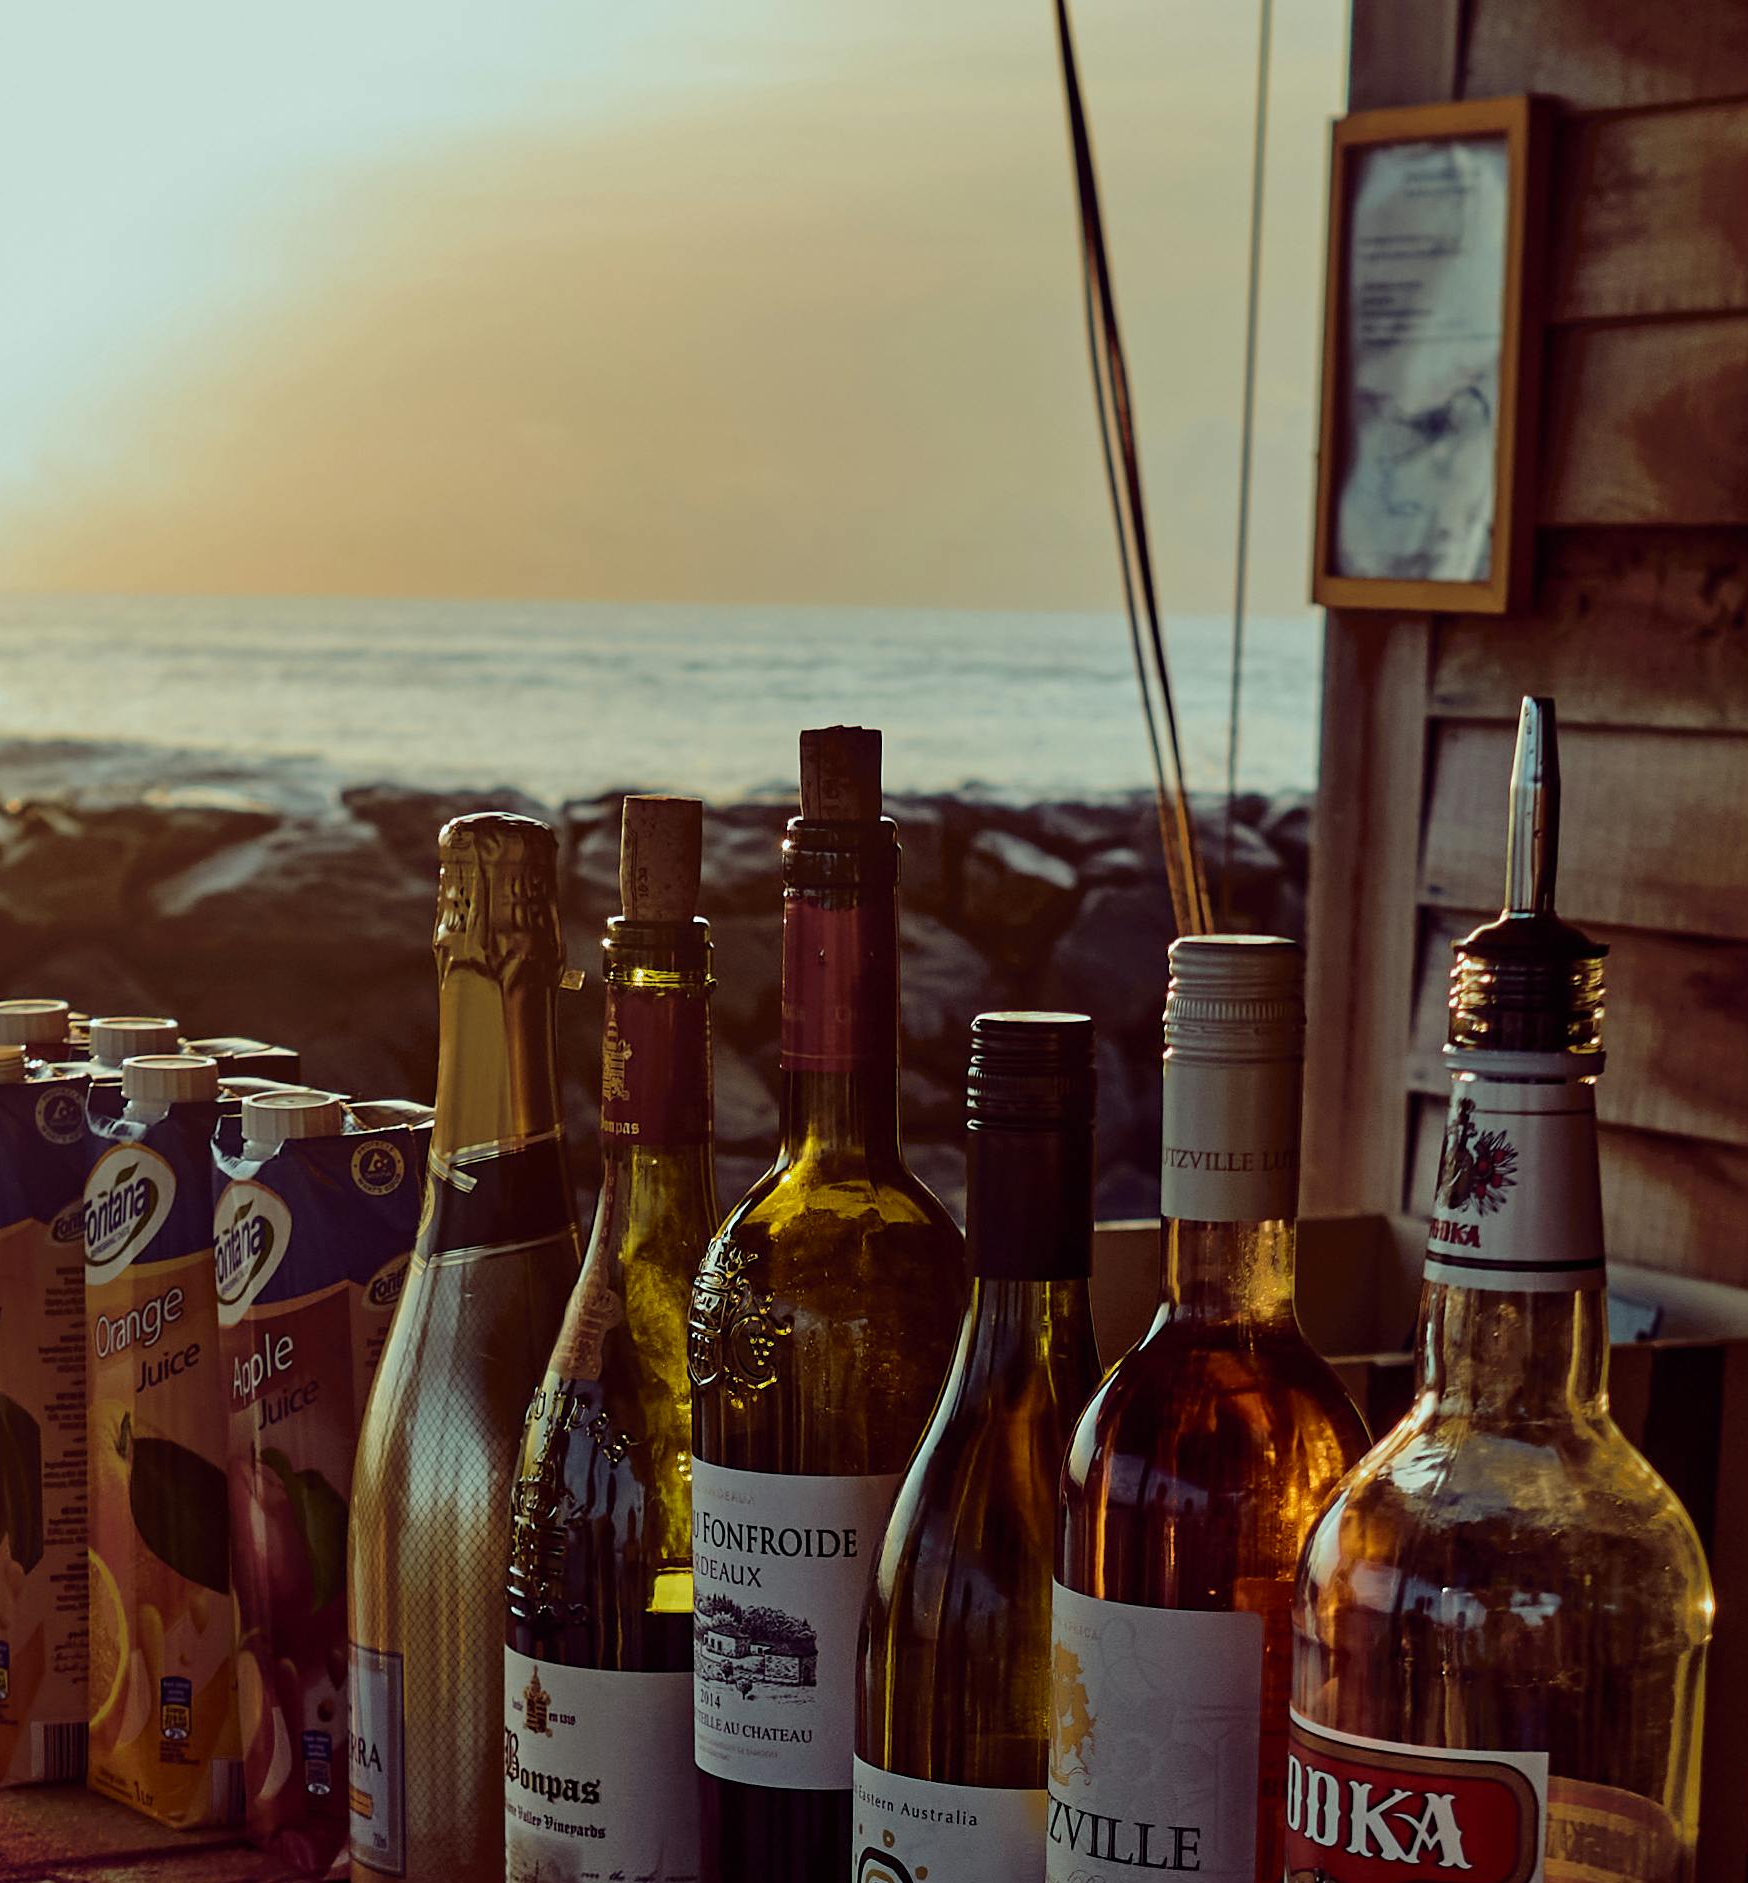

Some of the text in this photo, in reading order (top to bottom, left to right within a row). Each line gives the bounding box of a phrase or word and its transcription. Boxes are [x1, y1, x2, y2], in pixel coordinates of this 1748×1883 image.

[96, 1286, 184, 1359] Orange
[137, 1343, 200, 1393] Juice
[233, 1332, 294, 1402] Apple
[259, 1380, 319, 1430] Juice
[702, 1511, 858, 1559] FONFROIDE
[700, 1688, 722, 1709] 2014
[742, 1725, 813, 1743] CHATEAU
[505, 1727, 601, 1805] Bonpas
[544, 1814, 607, 1839] Vineyards
[901, 1802, 978, 1827] Australia
